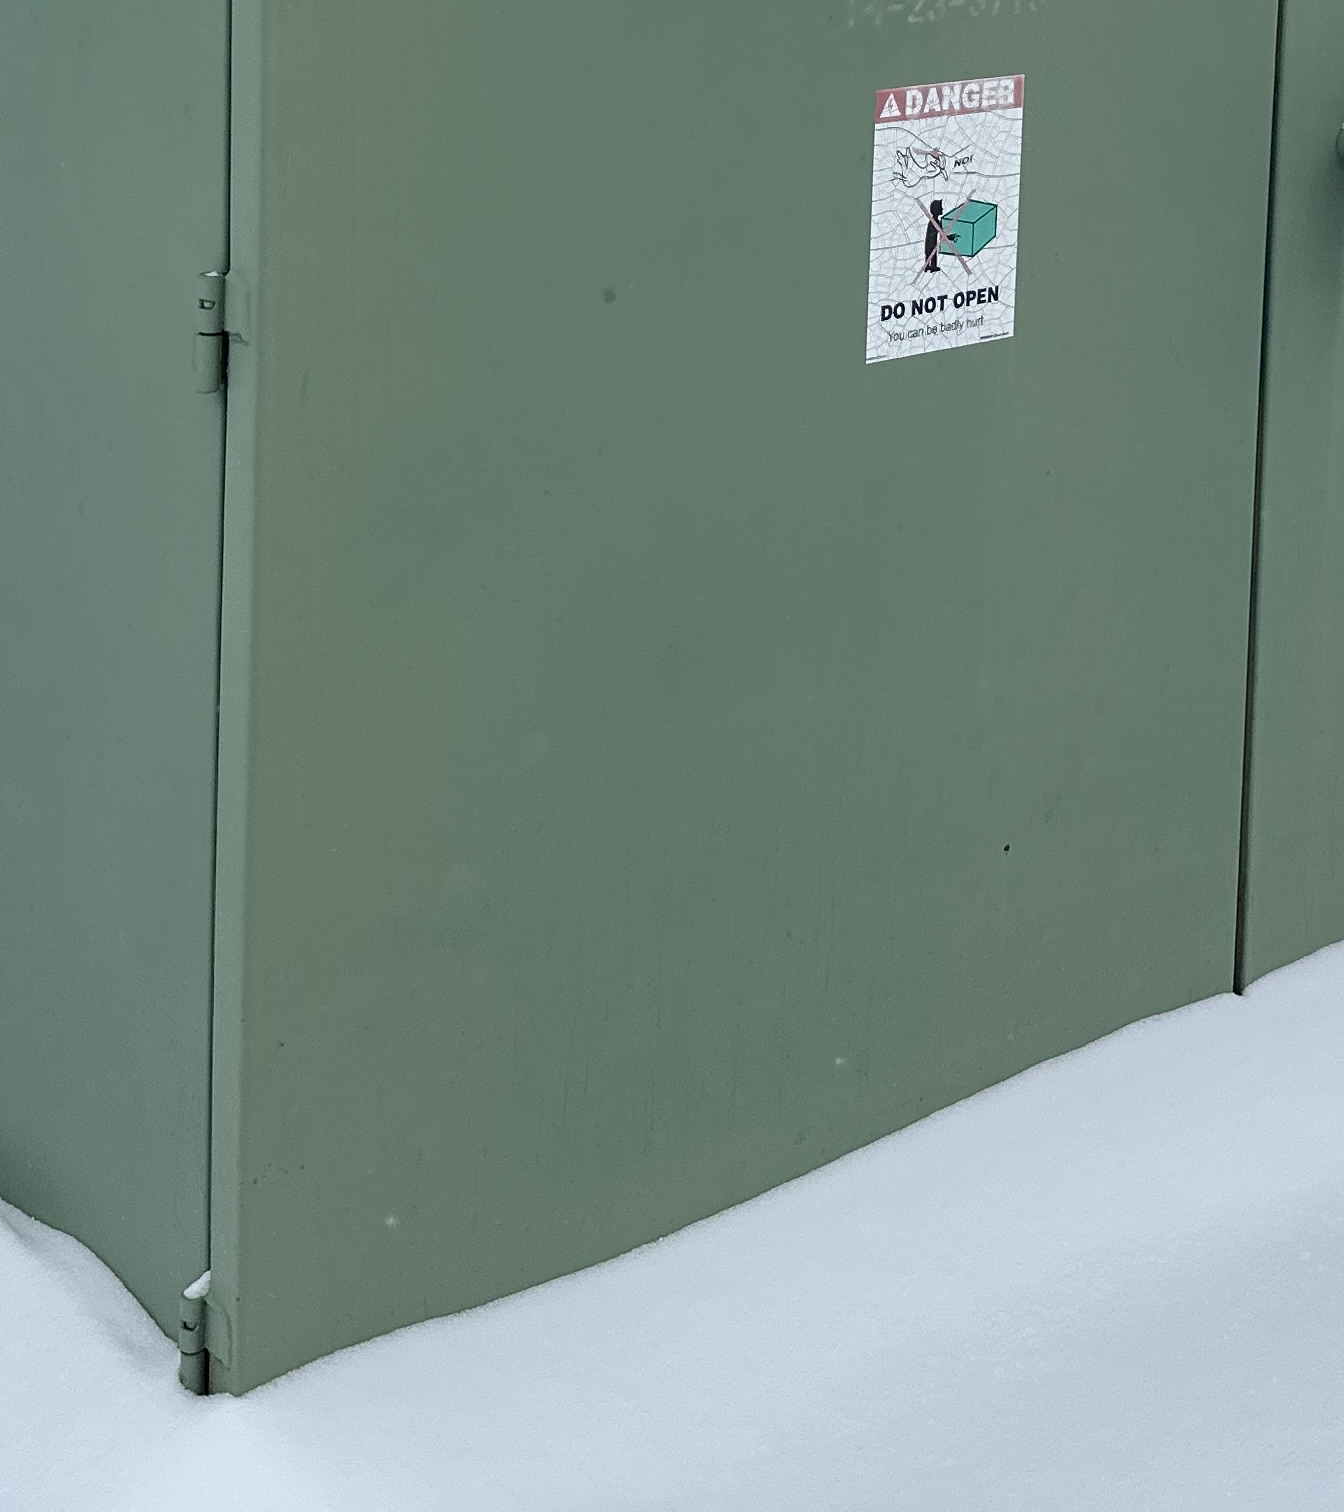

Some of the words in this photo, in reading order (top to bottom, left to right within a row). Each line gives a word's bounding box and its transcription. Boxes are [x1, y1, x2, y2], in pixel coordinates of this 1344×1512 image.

[905, 78, 1015, 116] DANGER
[880, 302, 906, 322] DO
[911, 295, 949, 316] NOT
[953, 285, 1000, 309] OPEN
[889, 331, 905, 342] You
[907, 327, 924, 338] can
[926, 324, 938, 336] be
[940, 319, 964, 333] badly
[966, 315, 984, 329] hurt
